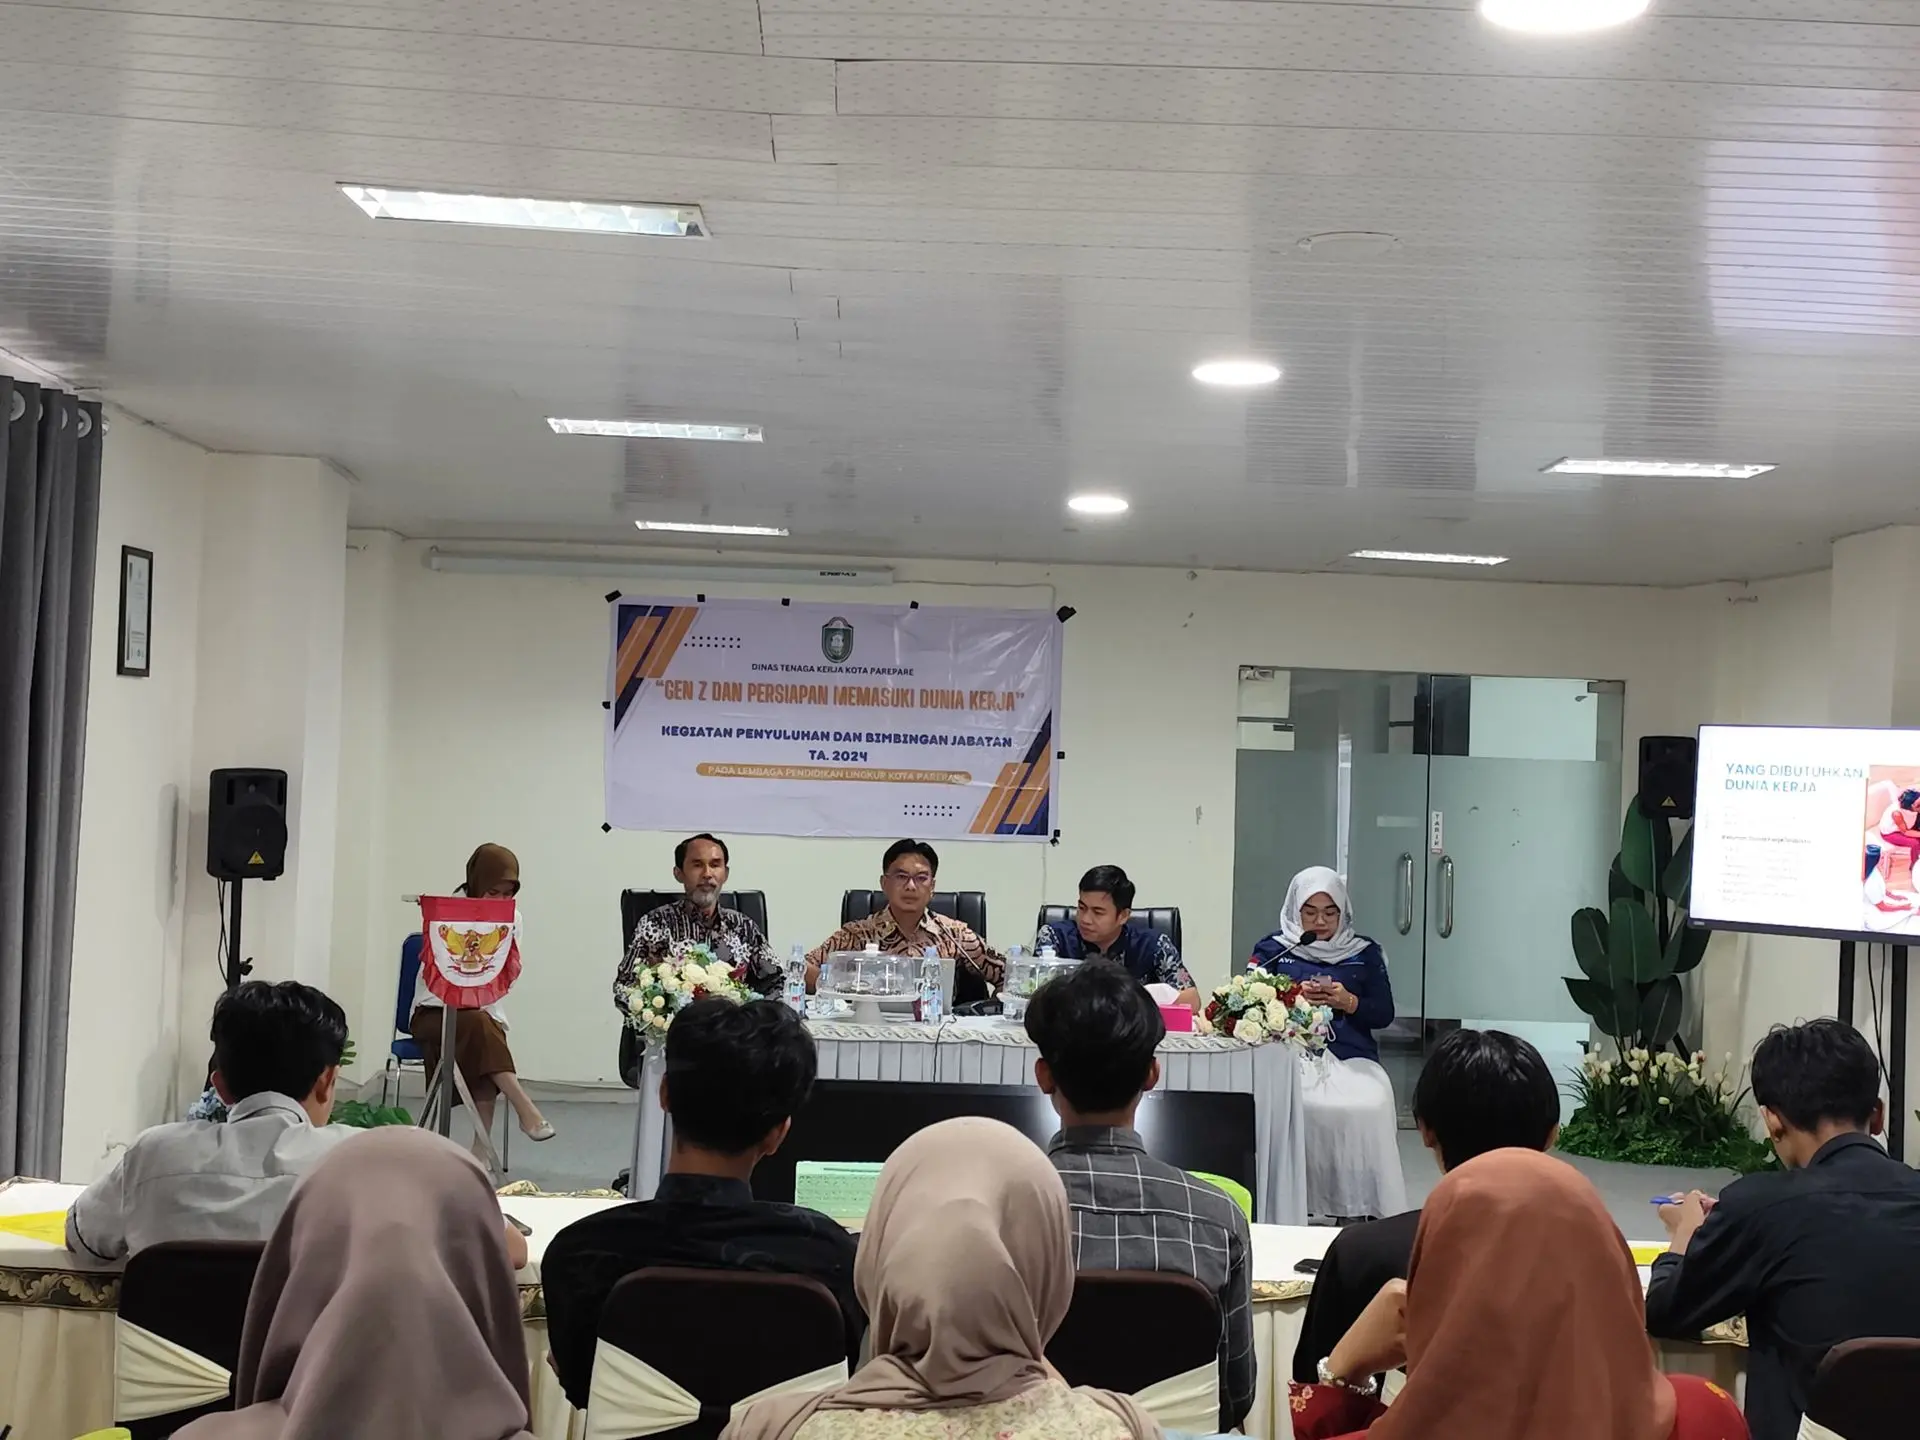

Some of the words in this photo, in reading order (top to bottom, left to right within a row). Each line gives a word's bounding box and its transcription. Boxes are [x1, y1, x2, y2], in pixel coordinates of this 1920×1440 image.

[751, 663, 778, 672] DINAS
[780, 664, 815, 673] TENAGA
[817, 666, 843, 674] KERJA
[845, 667, 868, 675] KOTA
[870, 667, 914, 676] PAREPARE
[699, 681, 707, 701] Z
[712, 681, 742, 702] DAN
[748, 683, 829, 705] PERSIAPAN
[833, 686, 915, 708] MEMASUKI
[919, 688, 964, 710] DUNIA
[661, 725, 733, 738] KEGIATAN
[736, 728, 830, 742] PENYULUHAN
[833, 731, 862, 742] DAN
[865, 733, 948, 745] BIMBINGAN
[951, 735, 1012, 747] JABATAN
[808, 749, 829, 761] TA.
[832, 750, 868, 762] 2024
[708, 766, 735, 775] PADA
[738, 767, 782, 777] LEMBAGA
[785, 768, 843, 778] PENDIDIKAN
[845, 770, 884, 779] LINGKUP
[886, 771, 914, 780] KOTA
[1726, 762, 1766, 776] YANG
[1769, 764, 1864, 778] DIBUTUHKAN
[1725, 778, 1769, 792] DUNIA
[1773, 780, 1817, 793] KERJA
